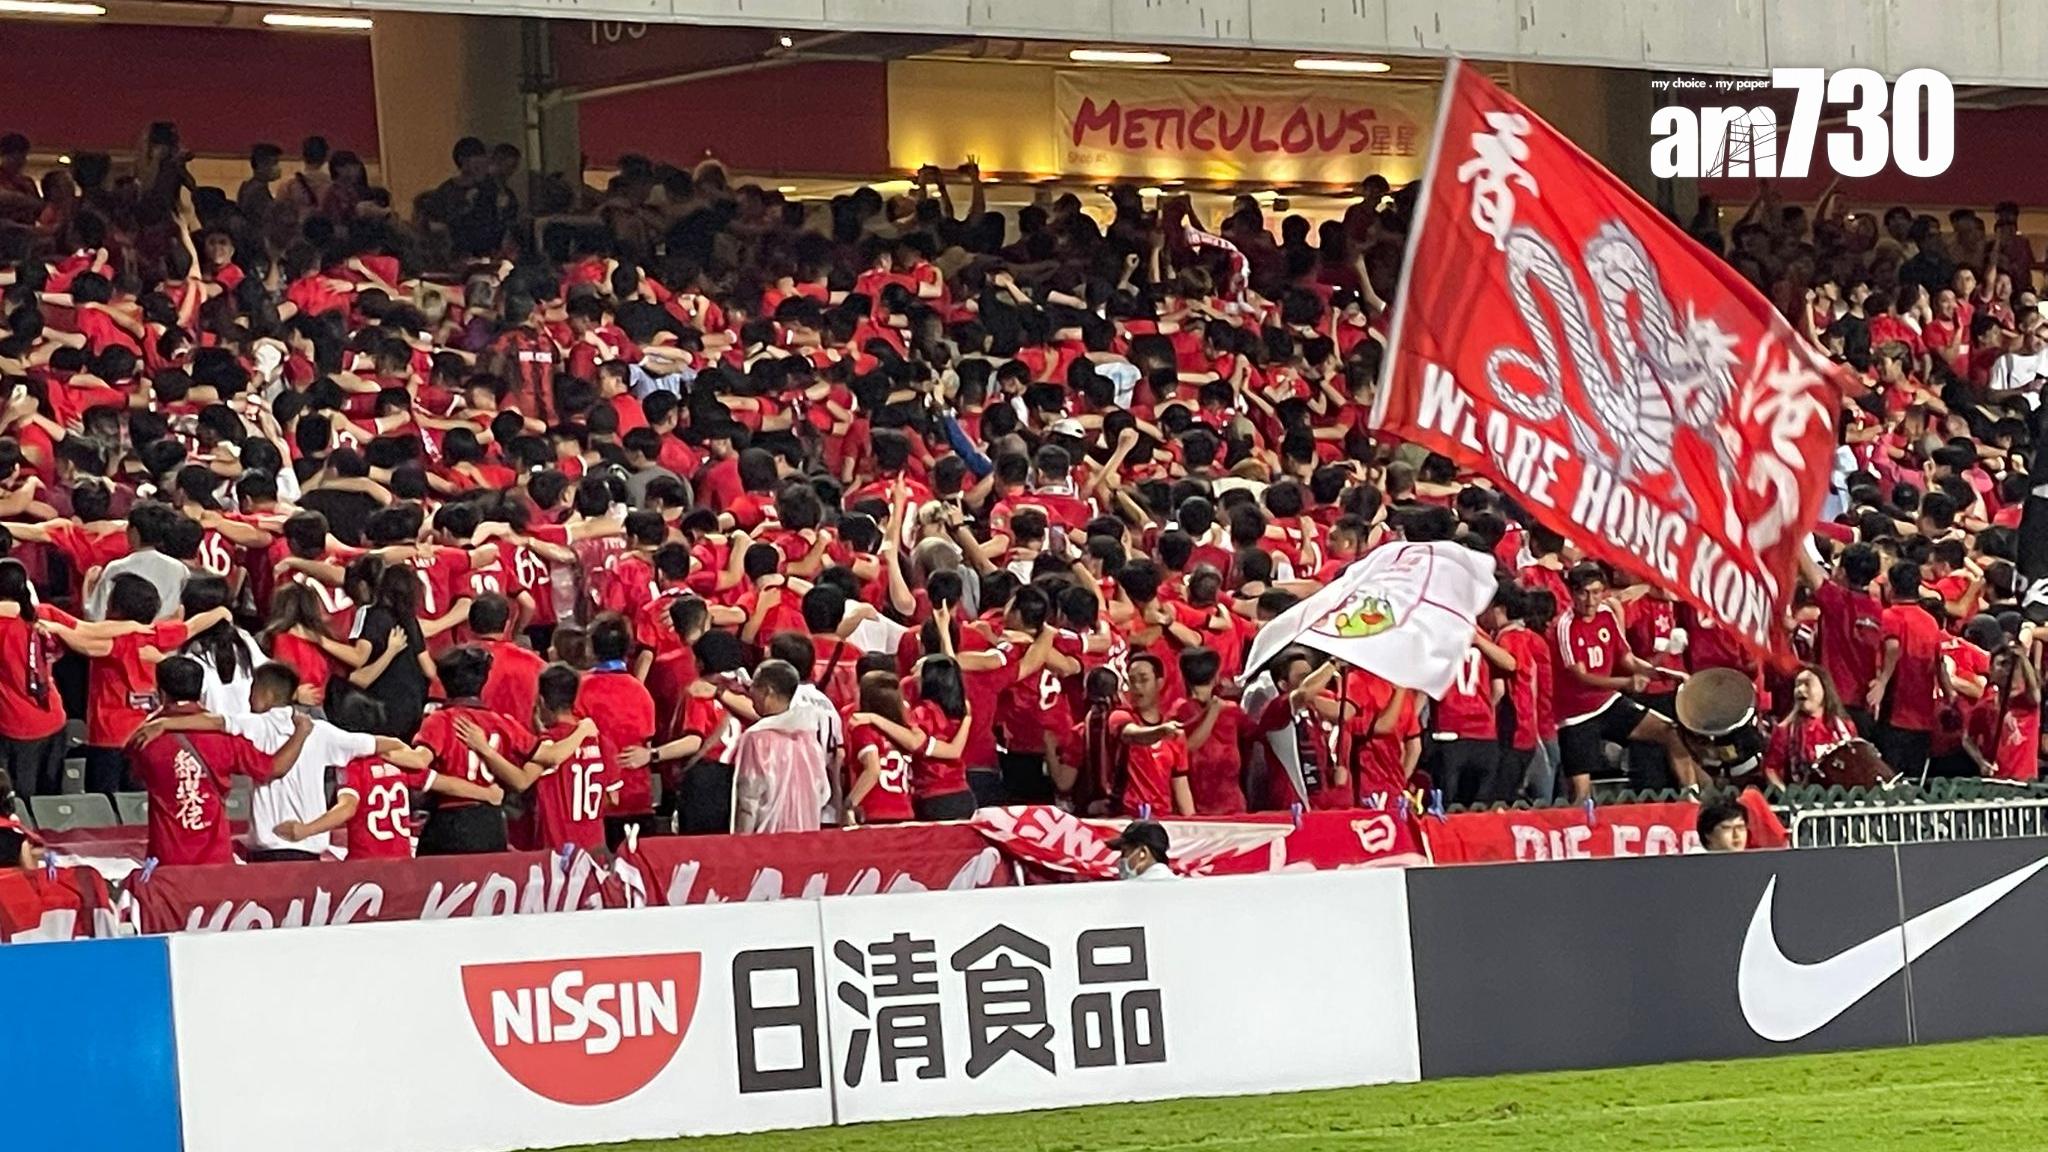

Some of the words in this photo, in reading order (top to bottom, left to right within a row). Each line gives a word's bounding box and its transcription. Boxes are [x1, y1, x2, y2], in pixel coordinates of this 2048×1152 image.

[1486, 408, 1572, 510] ARE
[1570, 461, 1688, 583] HONG
[1689, 531, 1774, 654] KON
[1587, 645, 1604, 669] 10
[367, 781, 411, 841] 22
[571, 762, 605, 822] 16
[492, 969, 679, 1056] NISSIN
[732, 923, 1167, 1094] 日清食品
